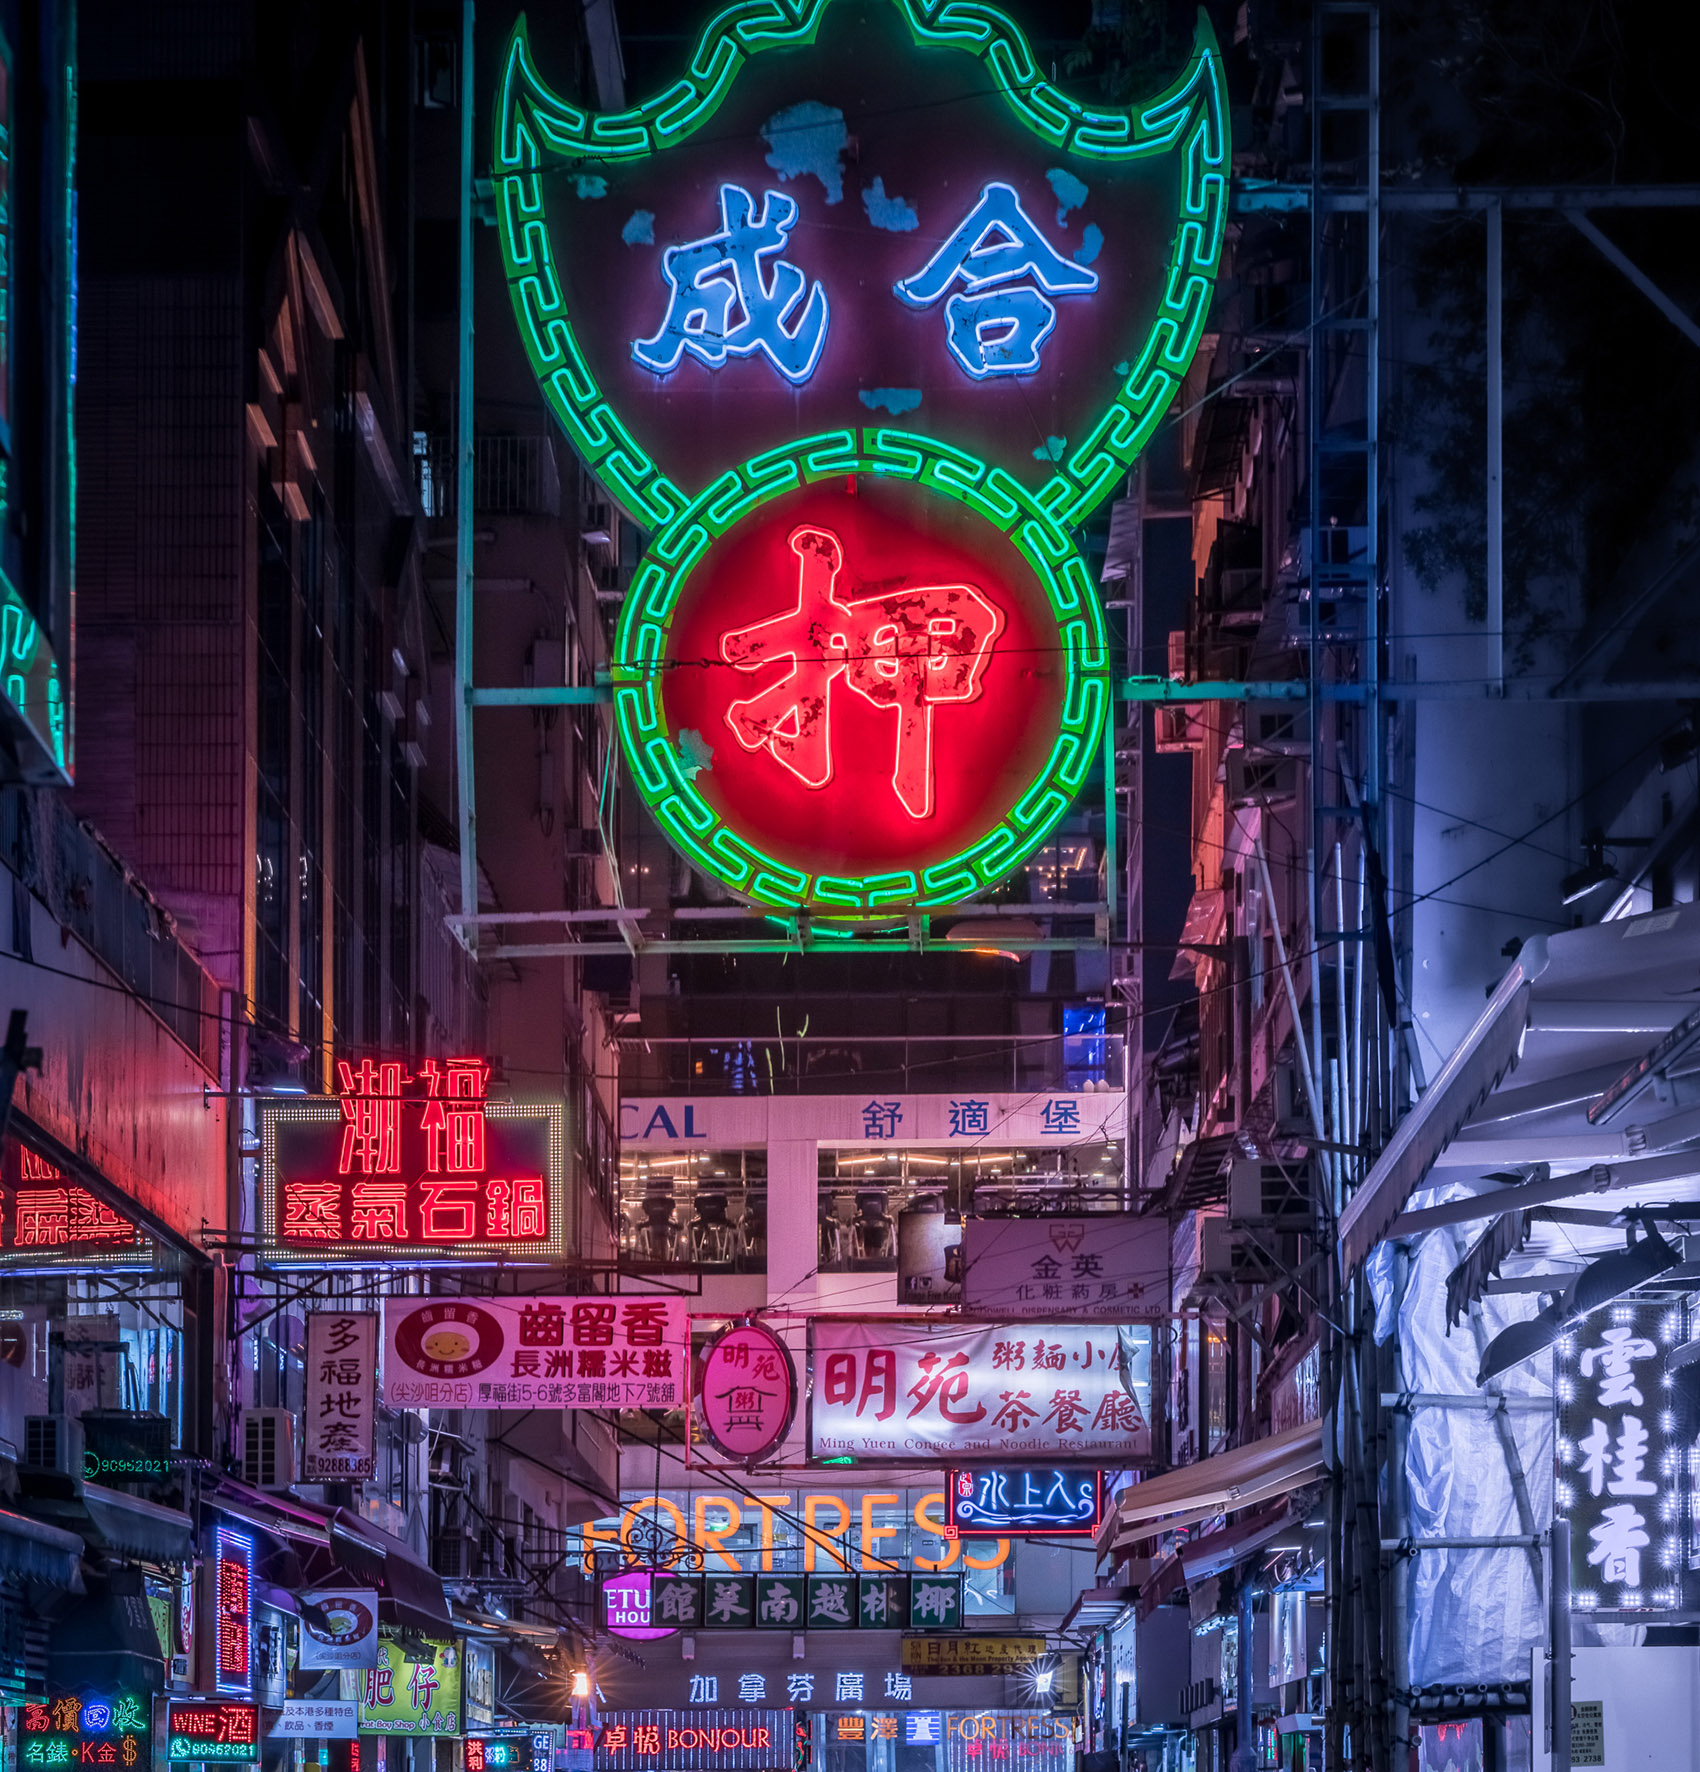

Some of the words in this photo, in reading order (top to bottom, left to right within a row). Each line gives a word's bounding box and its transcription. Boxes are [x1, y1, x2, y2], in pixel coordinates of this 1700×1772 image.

[718, 523, 1007, 820] 押
[338, 1058, 491, 1175] 潮福
[861, 1099, 1082, 1139] 舒適堡
[282, 1178, 548, 1241] 蒸氣石鍋
[1030, 1253, 1104, 1281] 金英
[518, 1301, 670, 1347] 齒留香
[722, 1342, 781, 1382] 明苑
[823, 1348, 987, 1425] 明苑
[819, 1437, 855, 1451] Ming
[862, 1437, 896, 1449] Yuen
[904, 1438, 956, 1452] Congee
[963, 1438, 991, 1450] and
[1000, 1438, 1050, 1450] Noodle
[1058, 1437, 1138, 1450] Restaurant
[1577, 1326, 1659, 1588] 雲桂香
[364, 1662, 440, 1711] 肥仔
[688, 1672, 914, 1703] 加拿芬廣場
[173, 1713, 216, 1733] WINE
[218, 1706, 255, 1743] 酒
[393, 1720, 416, 1732] Shop
[667, 1728, 772, 1753] BONJOUR
[946, 1715, 1070, 1741] FORTRESS
